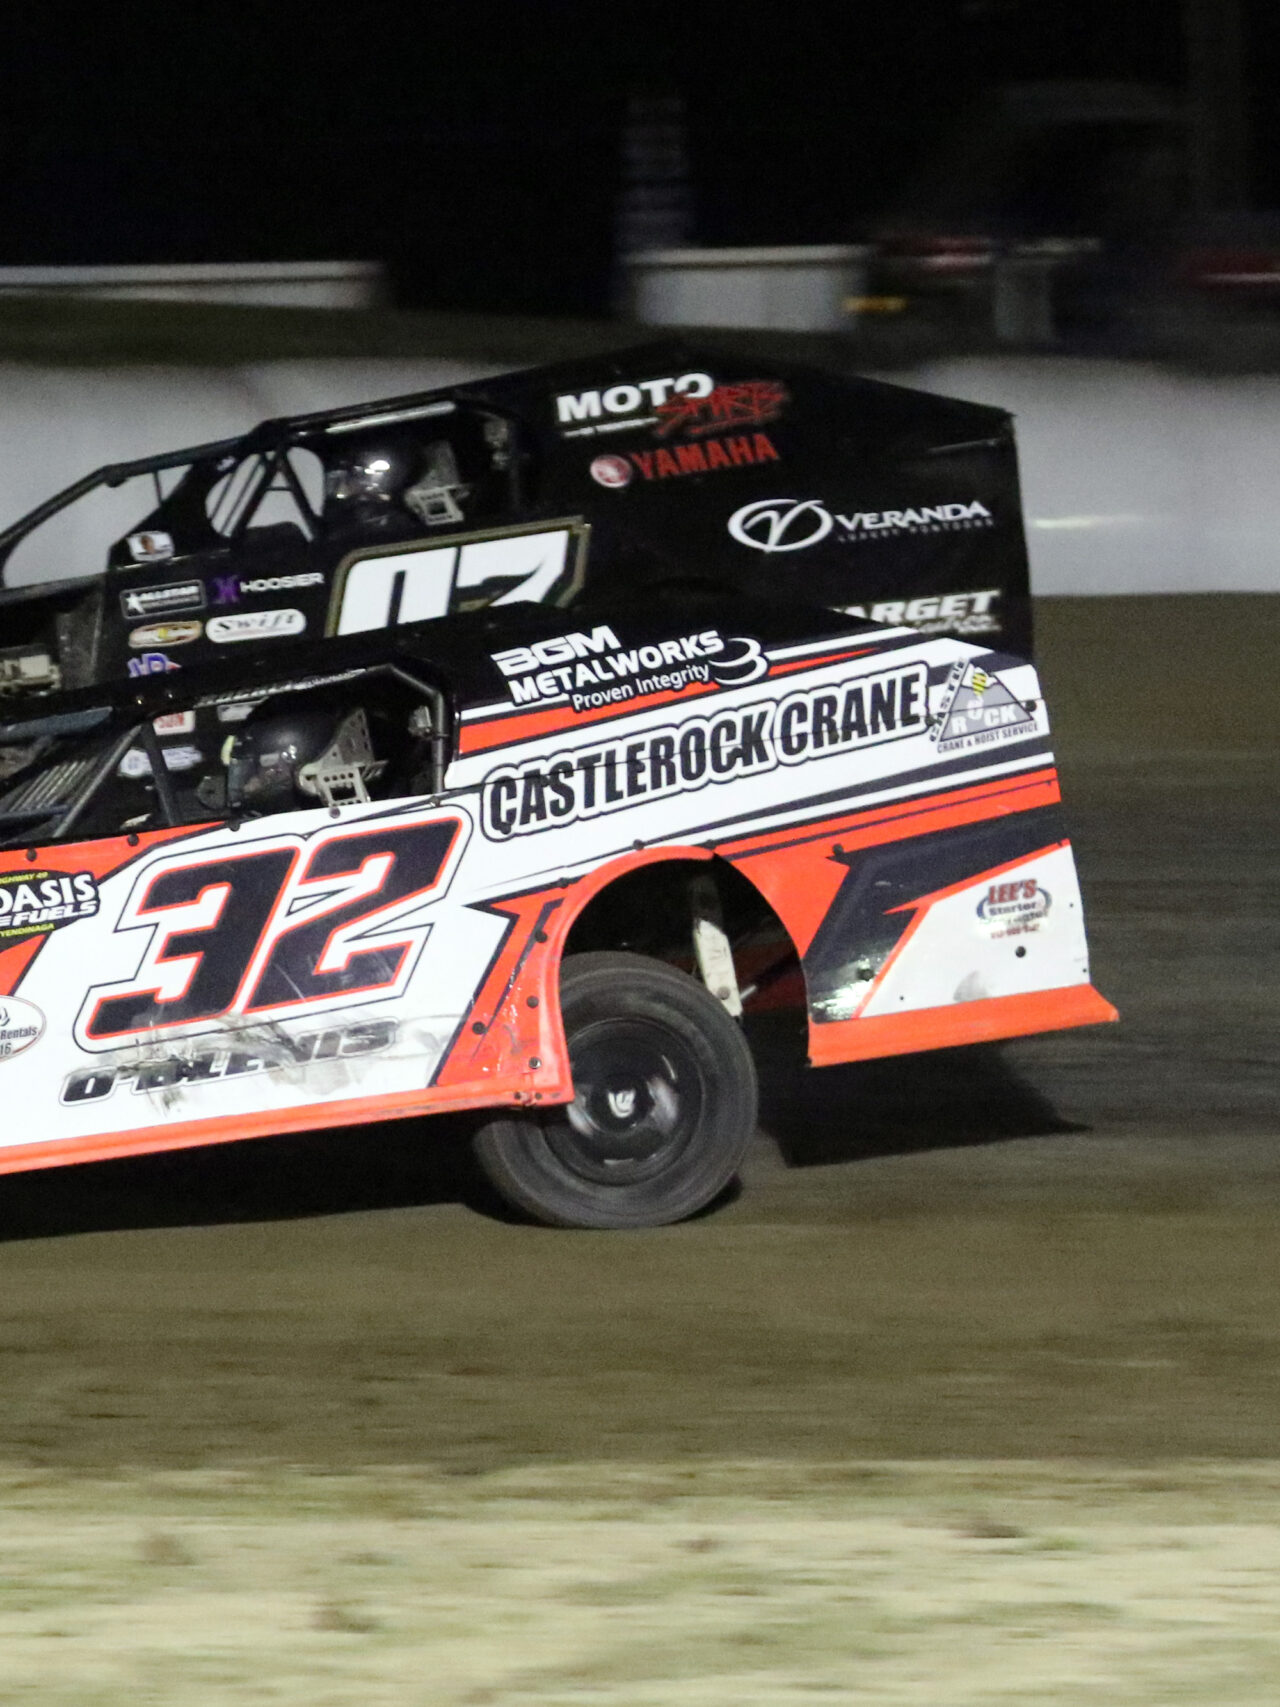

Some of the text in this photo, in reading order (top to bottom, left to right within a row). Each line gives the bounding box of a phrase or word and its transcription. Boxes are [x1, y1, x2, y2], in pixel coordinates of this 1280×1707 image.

[556, 372, 714, 423] MOTO
[630, 433, 781, 480] YAMAHA
[835, 500, 992, 532] VERANDA
[239, 571, 326, 594] HOOSIER
[831, 589, 1001, 626] RGET
[490, 624, 622, 677] BGM
[507, 630, 725, 704] METALWORKS
[573, 663, 710, 711] Proven Integrity
[777, 671, 923, 757] CRANE
[11, 900, 98, 927] FUELS
[987, 878, 1038, 905] LEE'S
[85, 815, 463, 1041] 32
[0, 1025, 39, 1041] Rentals
